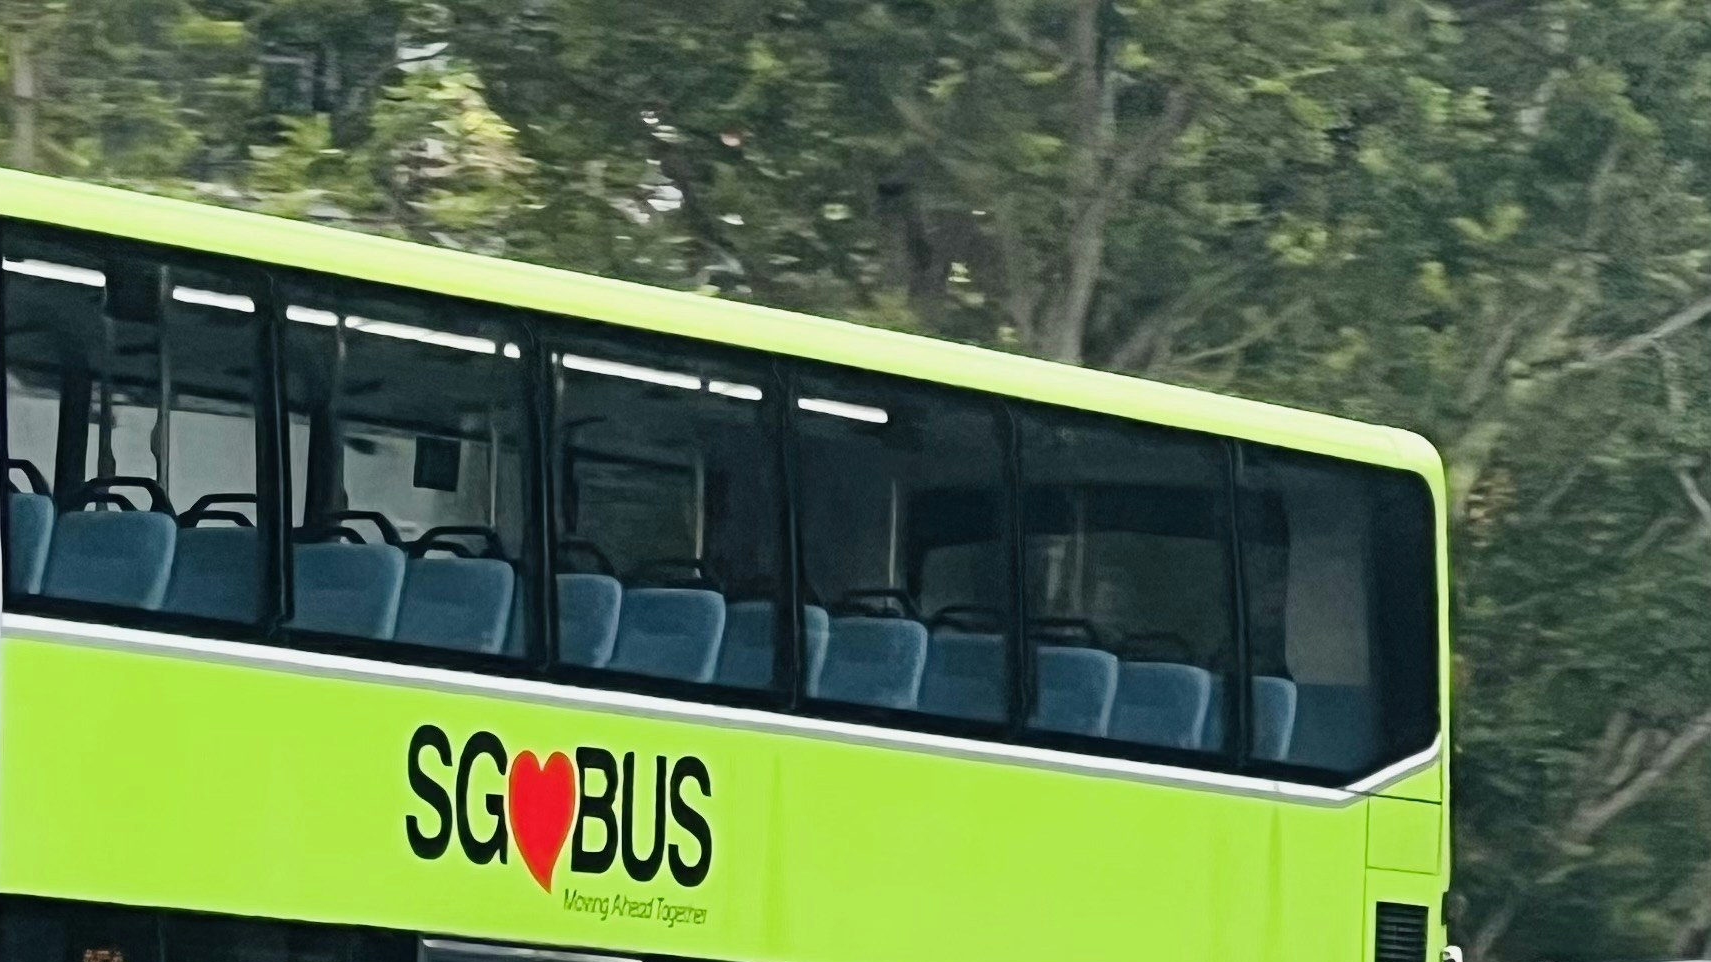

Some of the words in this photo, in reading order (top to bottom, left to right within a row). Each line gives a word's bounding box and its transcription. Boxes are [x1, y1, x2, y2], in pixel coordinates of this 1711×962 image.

[563, 888, 609, 921] Moving
[611, 894, 654, 919] Ahead
[656, 897, 707, 928] Together
